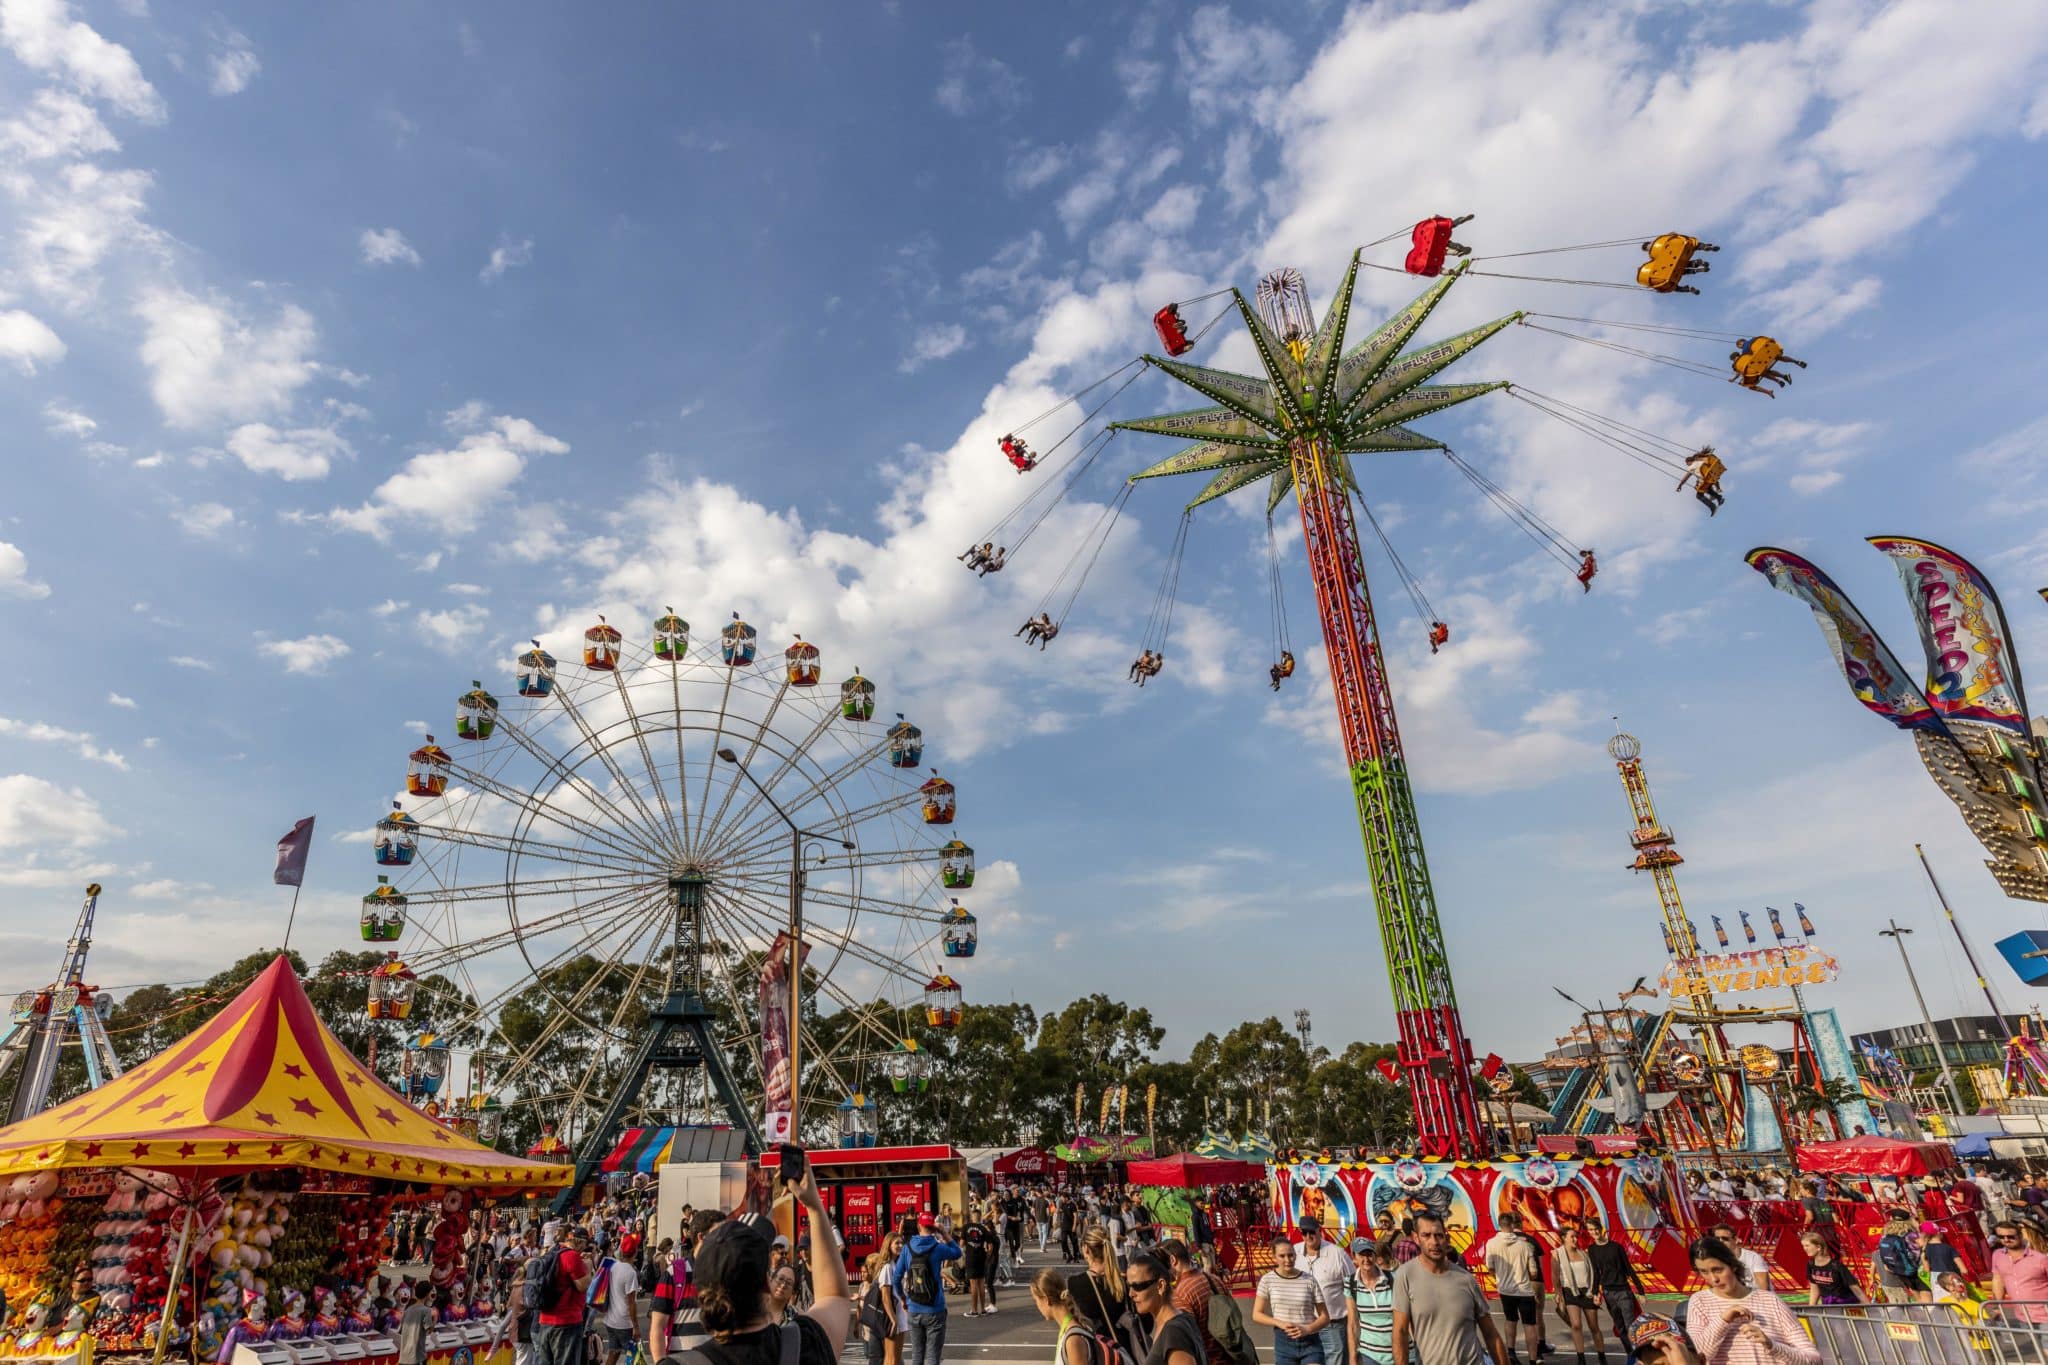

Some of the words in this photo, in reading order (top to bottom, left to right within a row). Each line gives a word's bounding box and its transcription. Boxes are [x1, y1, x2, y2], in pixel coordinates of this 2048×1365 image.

[1369, 312, 1415, 352] FLYER
[1401, 344, 1455, 371] FLYER
[1915, 561, 1969, 672] SPEED
[1936, 671, 1966, 701] 2
[1671, 962, 1827, 998] REVENGE
